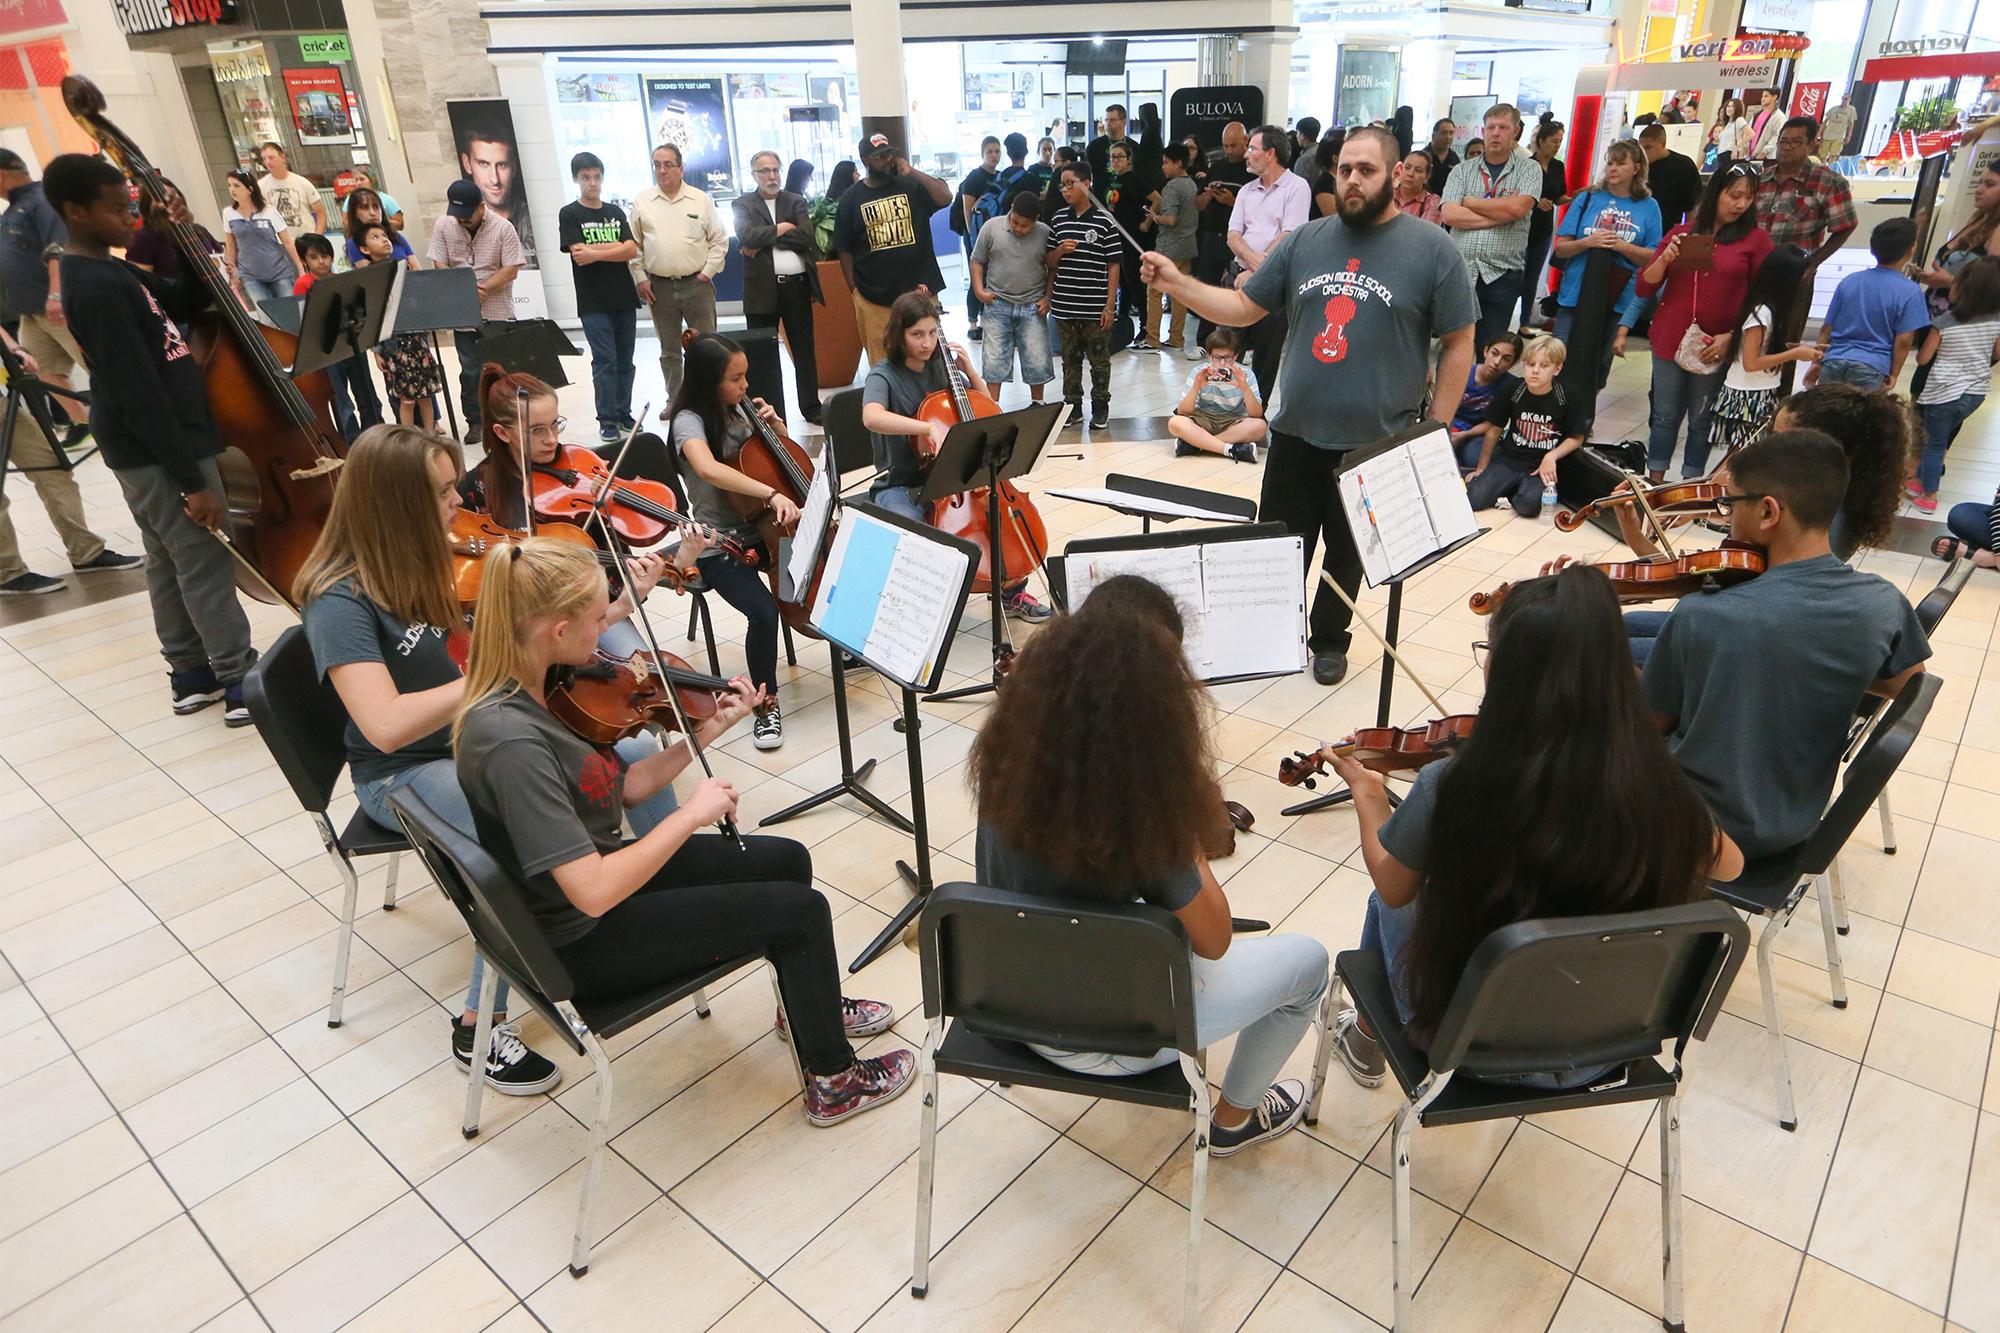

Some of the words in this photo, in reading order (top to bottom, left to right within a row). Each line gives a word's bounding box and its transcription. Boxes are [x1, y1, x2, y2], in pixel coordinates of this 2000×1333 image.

[303, 40, 345, 53] cricket
[1680, 37, 1772, 61] verizon
[1720, 64, 1770, 77] wireless
[1342, 74, 1374, 89] ADORN
[1185, 102, 1244, 116] BULOVA
[1298, 273, 1334, 295] JUDSON
[1334, 271, 1366, 286] MIDDLE
[1364, 276, 1393, 307] SCHOOL
[1322, 284, 1369, 302] ORCHESTRA
